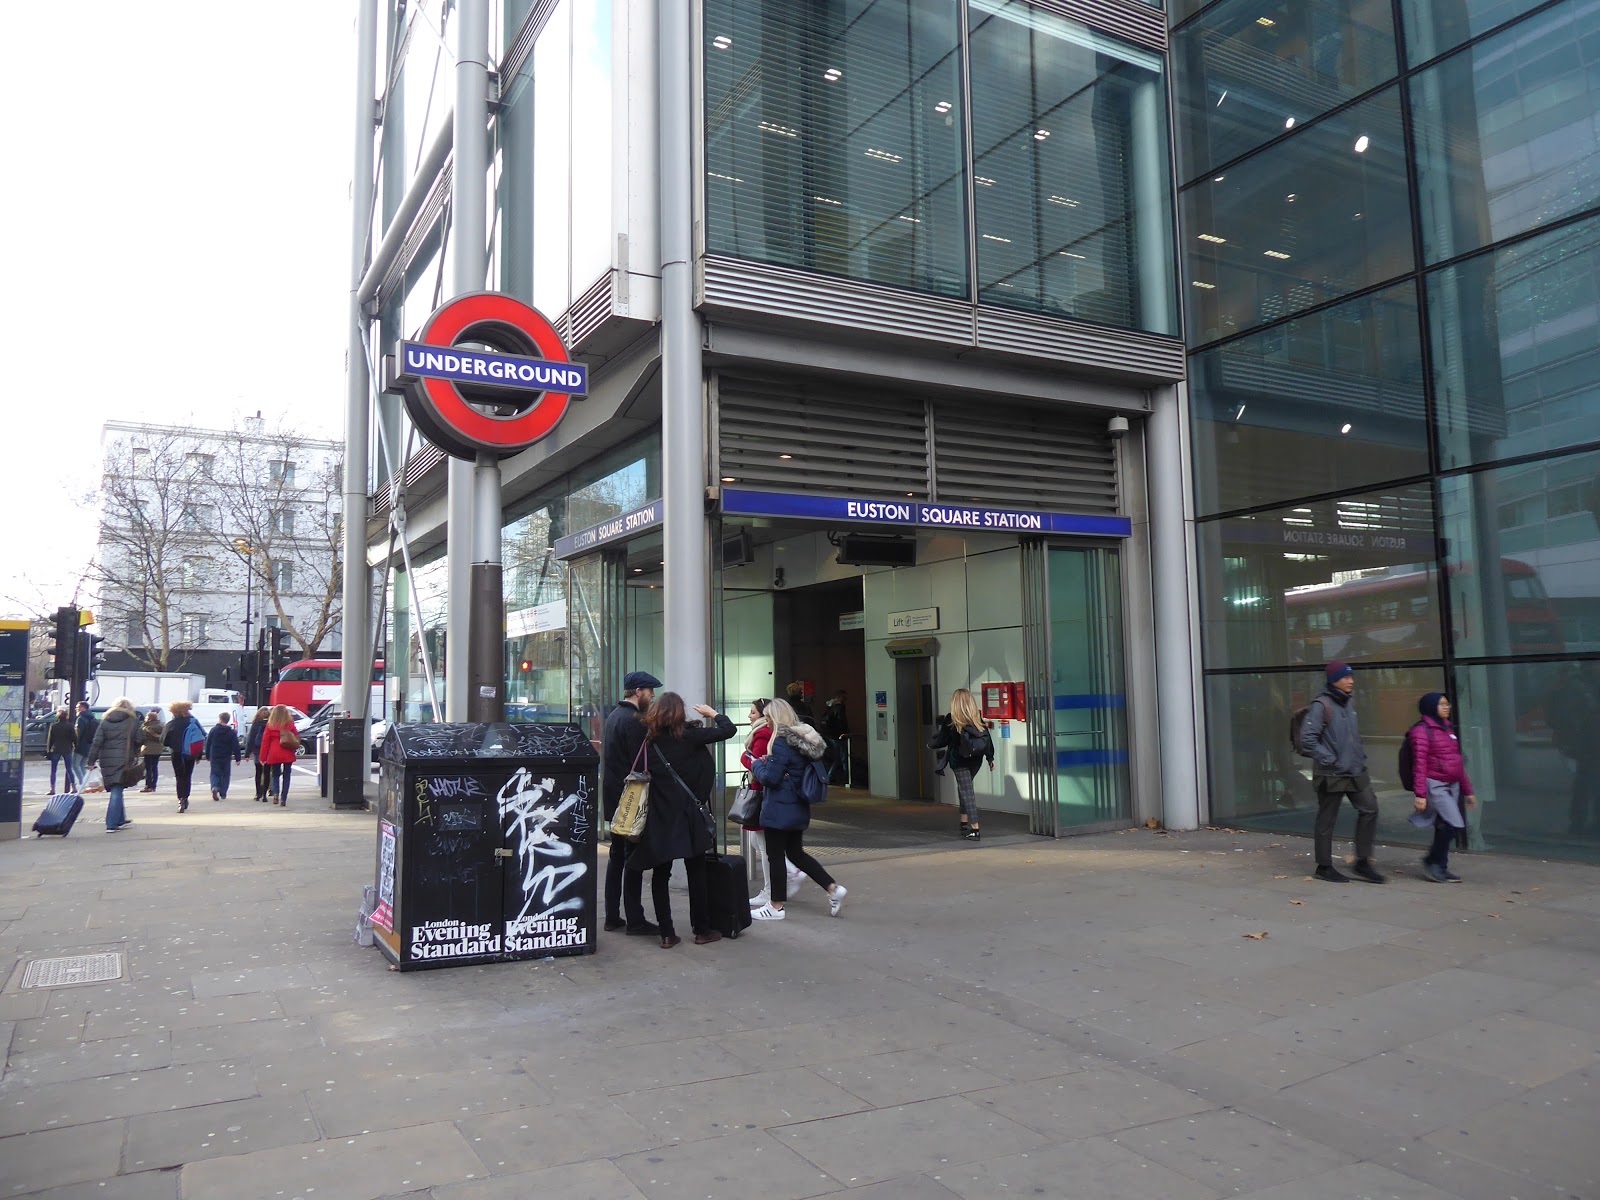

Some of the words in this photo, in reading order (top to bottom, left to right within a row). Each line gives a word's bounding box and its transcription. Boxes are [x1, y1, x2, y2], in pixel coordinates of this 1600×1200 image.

[408, 350, 582, 387] UNDERGROUND
[574, 529, 596, 549] EUSTON
[598, 519, 623, 540] SQUARE
[626, 507, 655, 530] STATION
[847, 501, 910, 520] EUSTON
[921, 507, 981, 526] SQUARE
[984, 511, 1041, 529] STATION
[893, 617, 904, 627] Lift
[411, 921, 492, 944] Evening
[425, 919, 460, 929] London
[410, 933, 502, 960] Standard
[504, 927, 588, 953] Standard
